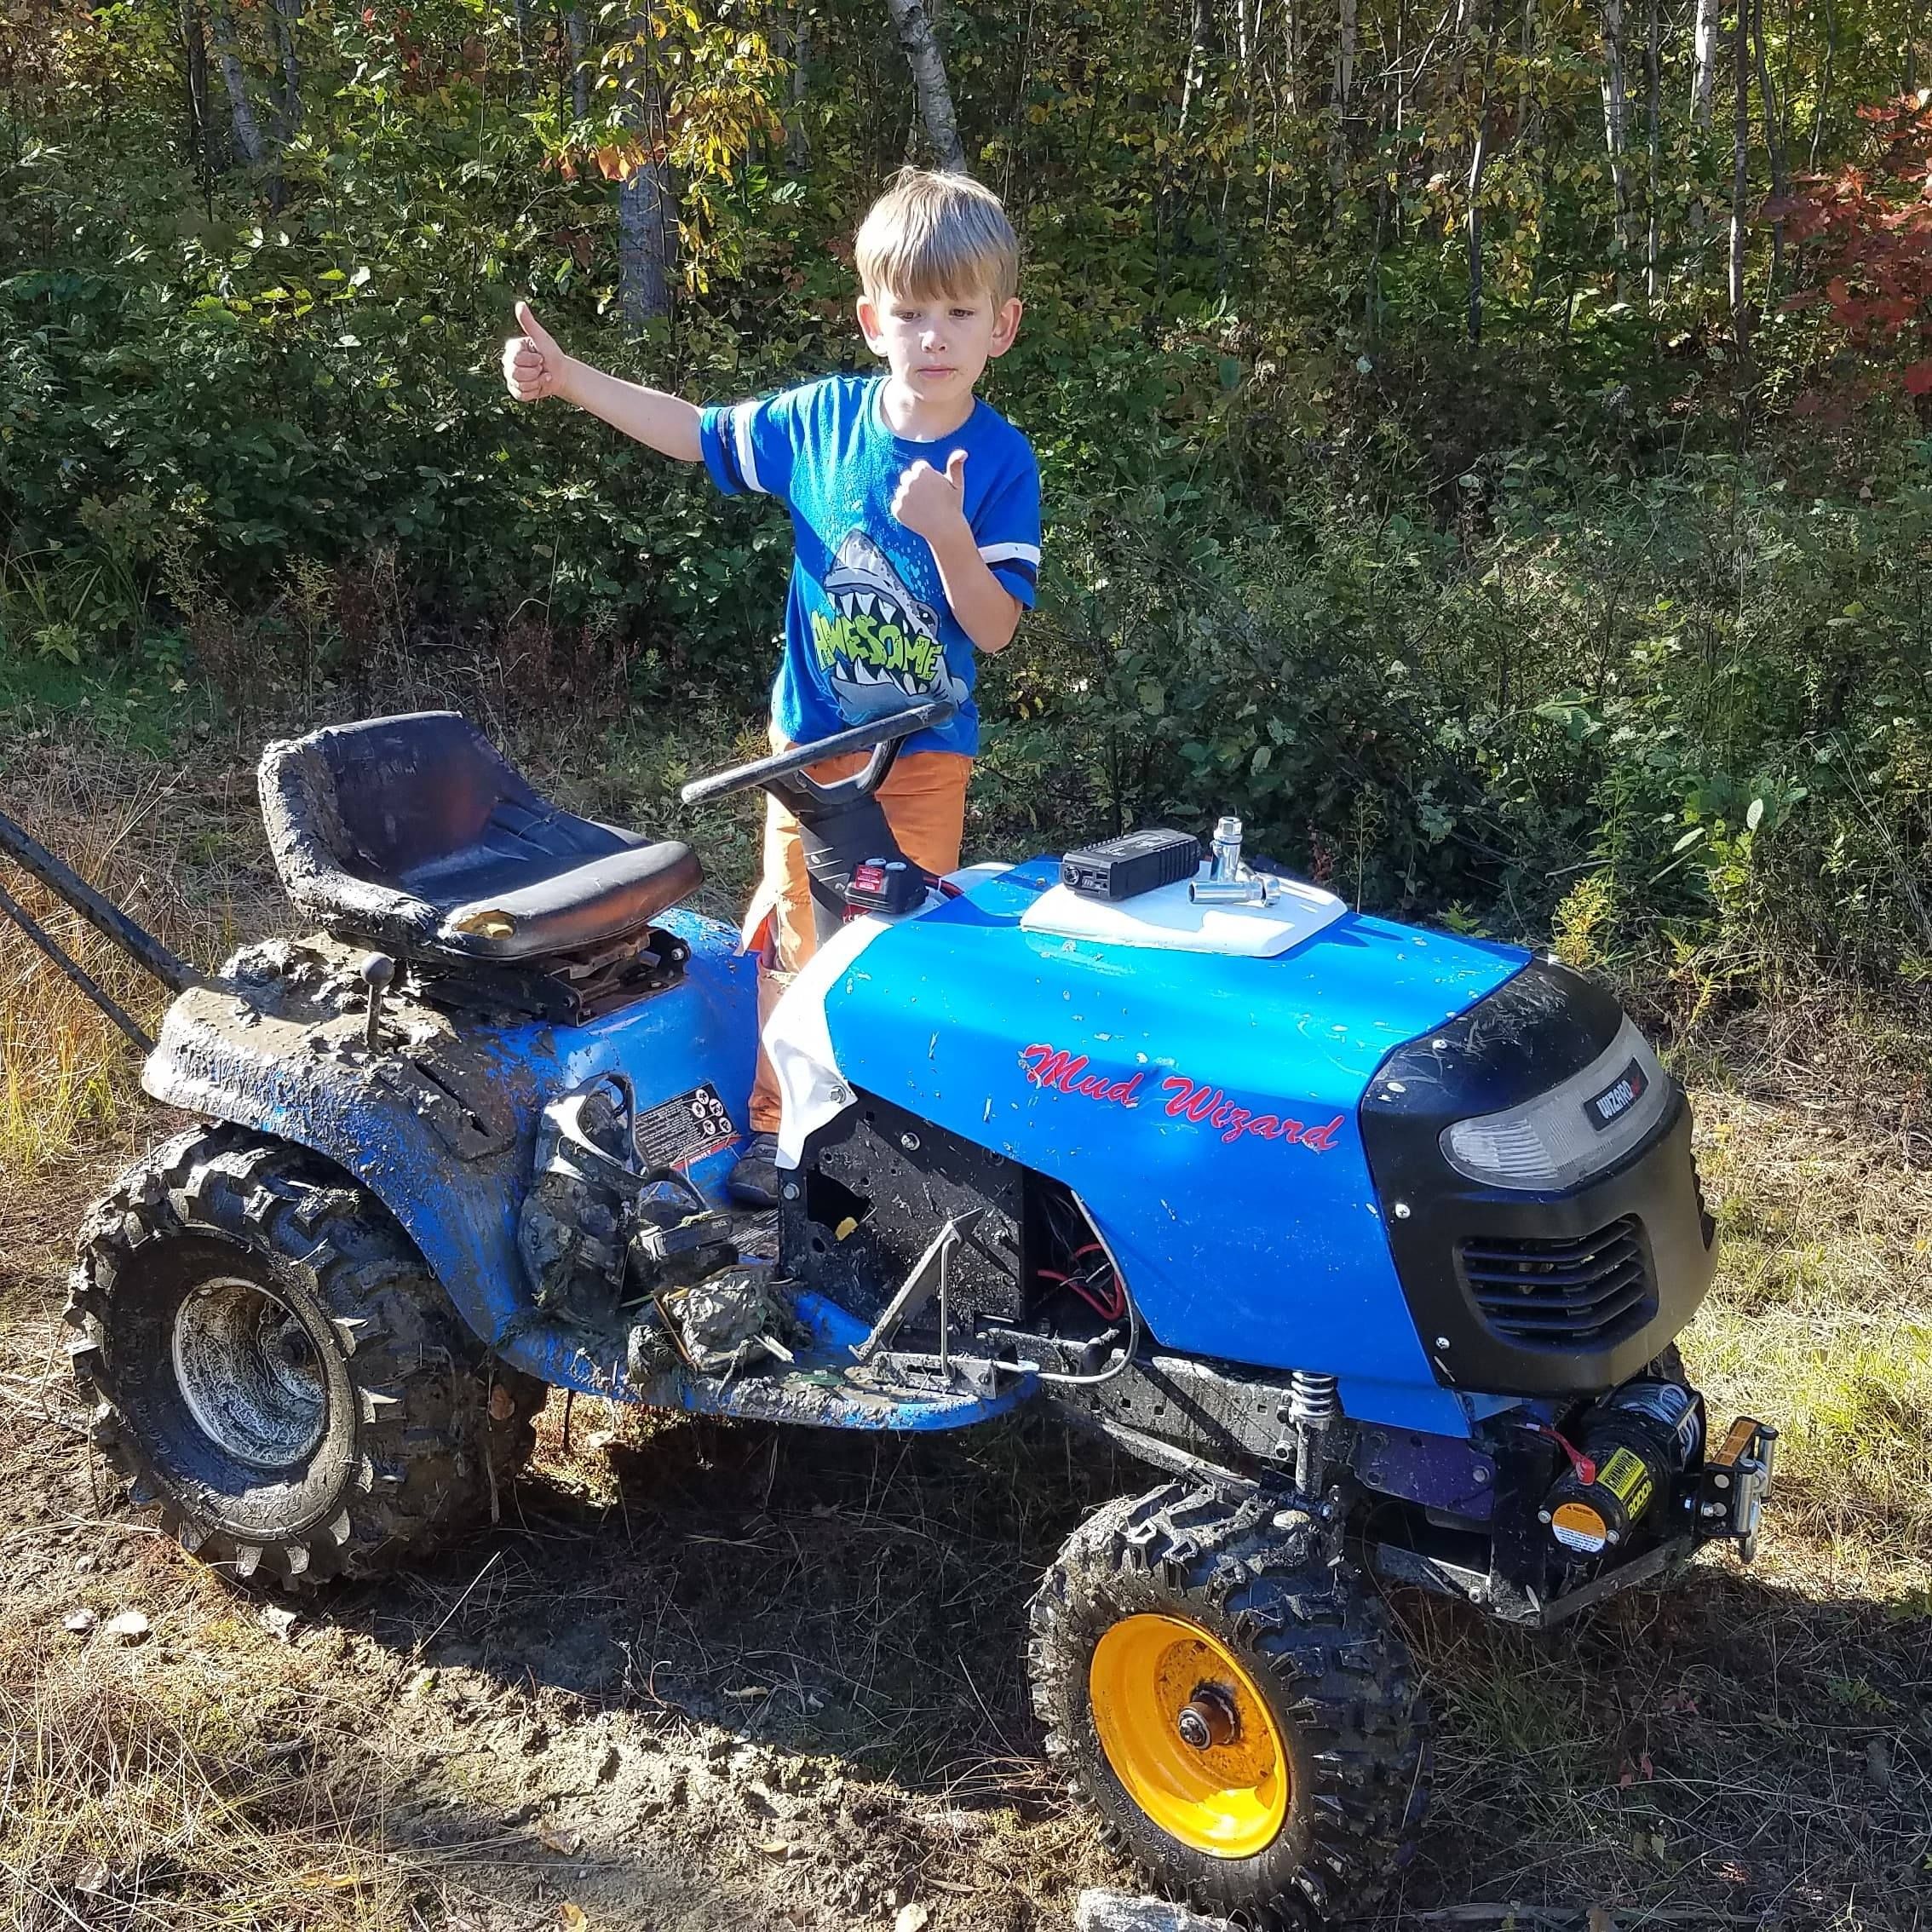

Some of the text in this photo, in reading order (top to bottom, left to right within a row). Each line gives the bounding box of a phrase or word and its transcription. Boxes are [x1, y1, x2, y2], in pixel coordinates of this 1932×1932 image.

[810, 610, 943, 681] AWESOME
[1023, 1044, 1346, 1151] Mud Wizard
[1596, 1079, 1634, 1119] WIZARD
[1604, 1452, 1638, 1490] CHAMPION
